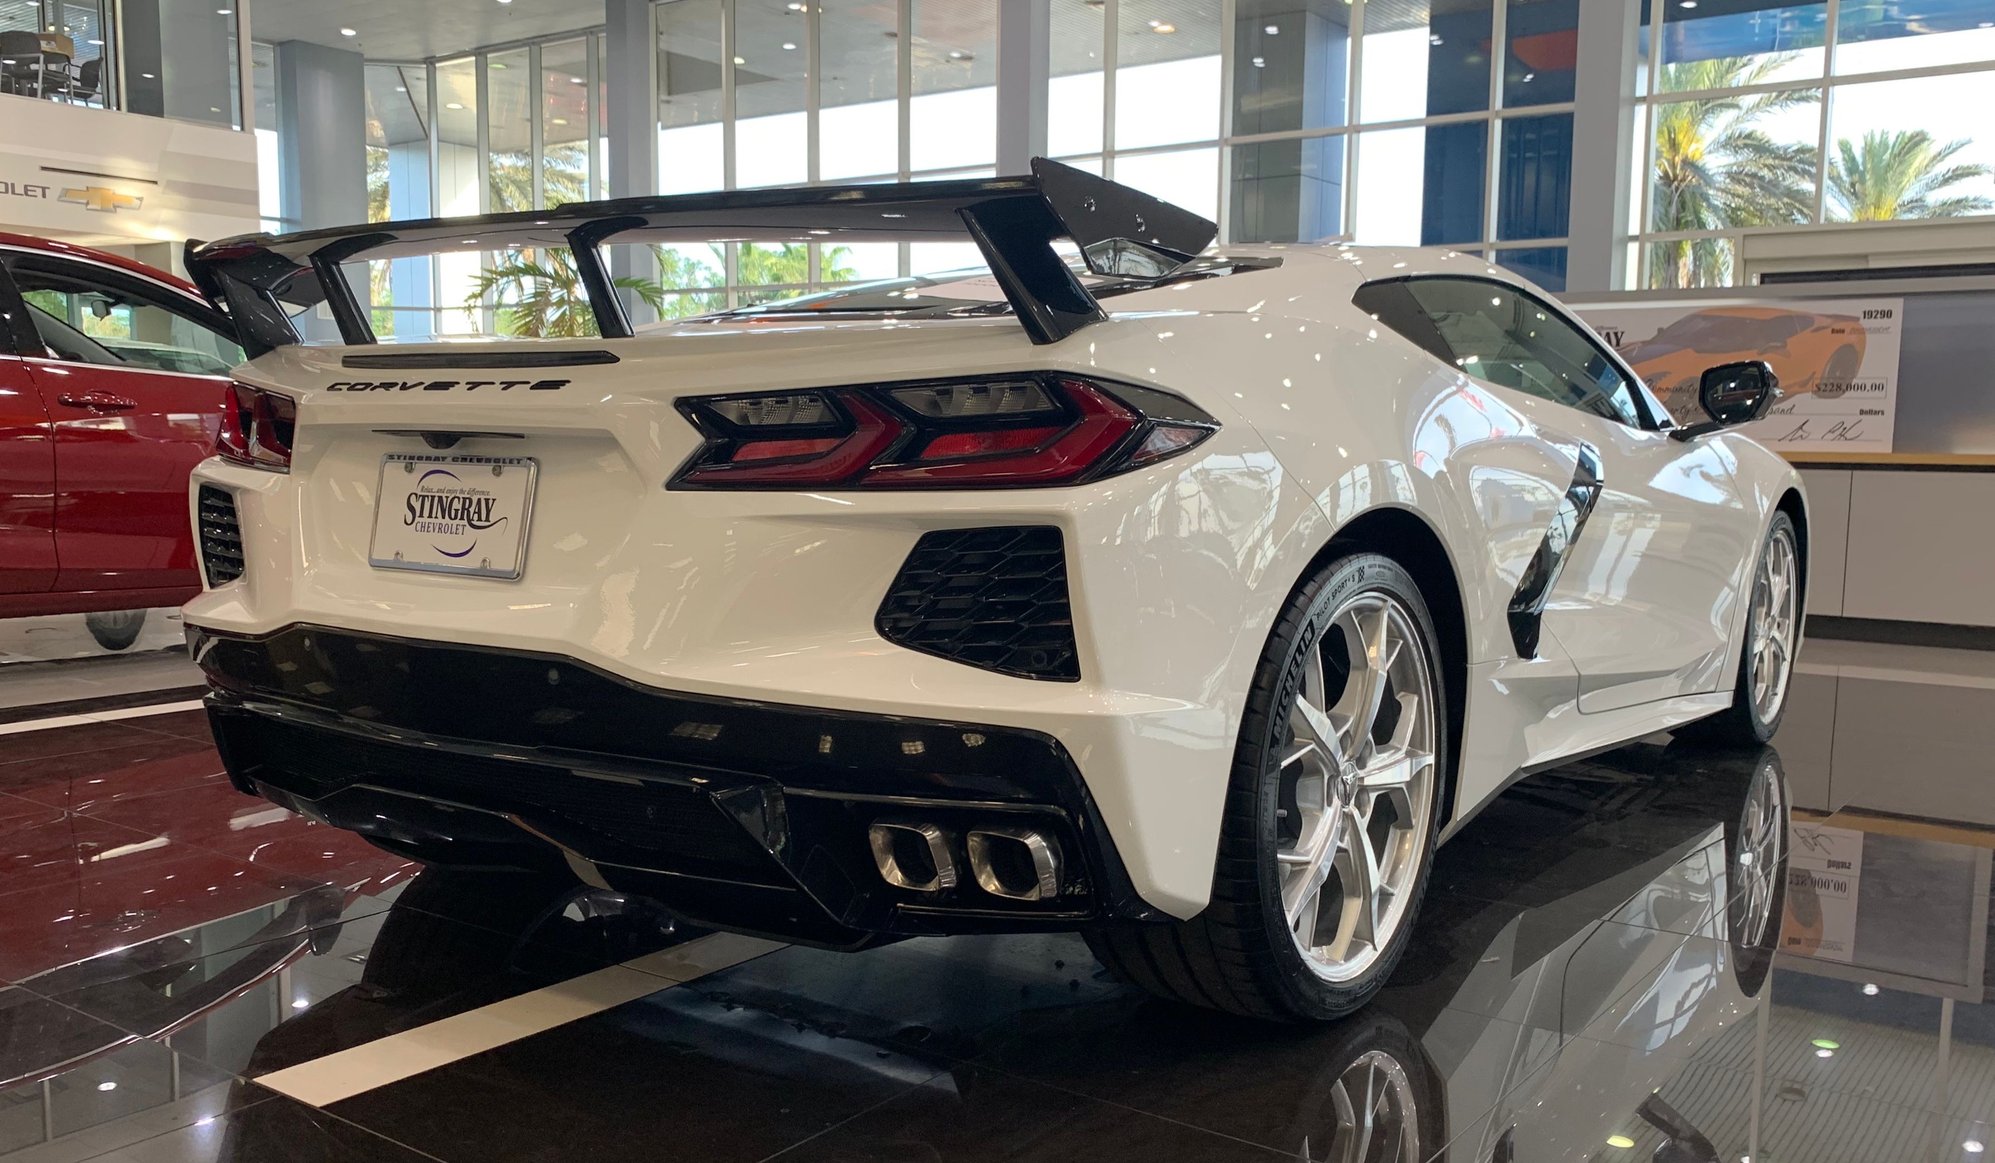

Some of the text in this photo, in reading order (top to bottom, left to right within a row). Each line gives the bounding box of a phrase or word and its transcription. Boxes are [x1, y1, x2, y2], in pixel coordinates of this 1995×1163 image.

[1862, 309, 1893, 320] 19290
[326, 379, 572, 392] CORVETTE
[1815, 381, 1884, 393] $228,000.00
[1859, 408, 1885, 416] Dollars
[388, 454, 523, 465] STINGRAY CHEVROLET
[404, 492, 504, 529] STINGRAY
[415, 521, 467, 535] CHEVROLET
[1273, 626, 1316, 742] MICHELIN
[1315, 597, 1332, 621] PILOT
[1331, 579, 1348, 601] SPORT
